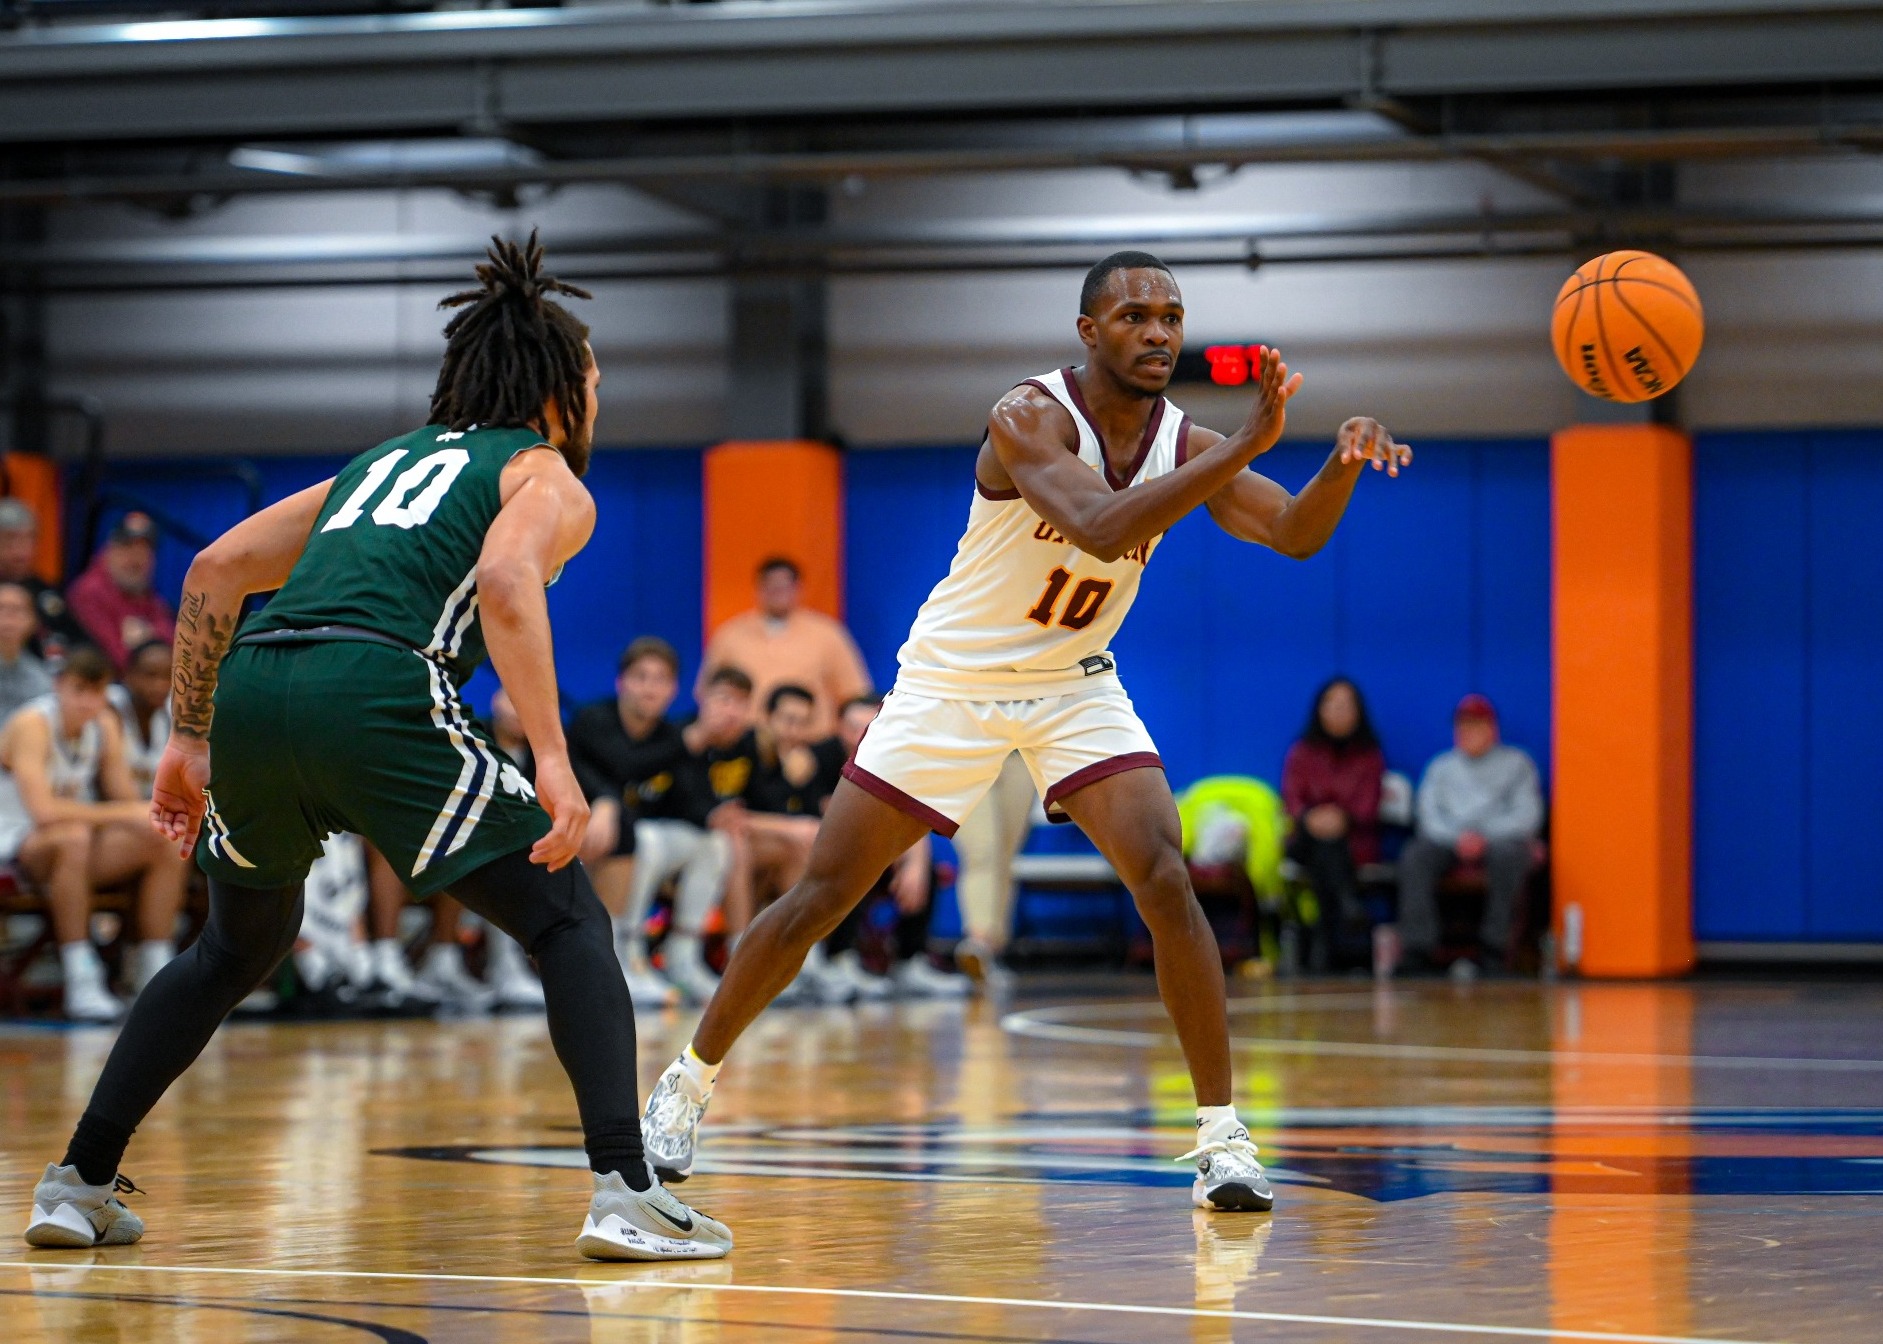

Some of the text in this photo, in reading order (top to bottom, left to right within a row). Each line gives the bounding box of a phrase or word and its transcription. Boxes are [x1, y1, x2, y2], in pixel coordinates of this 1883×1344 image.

[1622, 344, 1664, 395] NCAA
[320, 448, 471, 534] 10
[1025, 564, 1115, 632] 10
